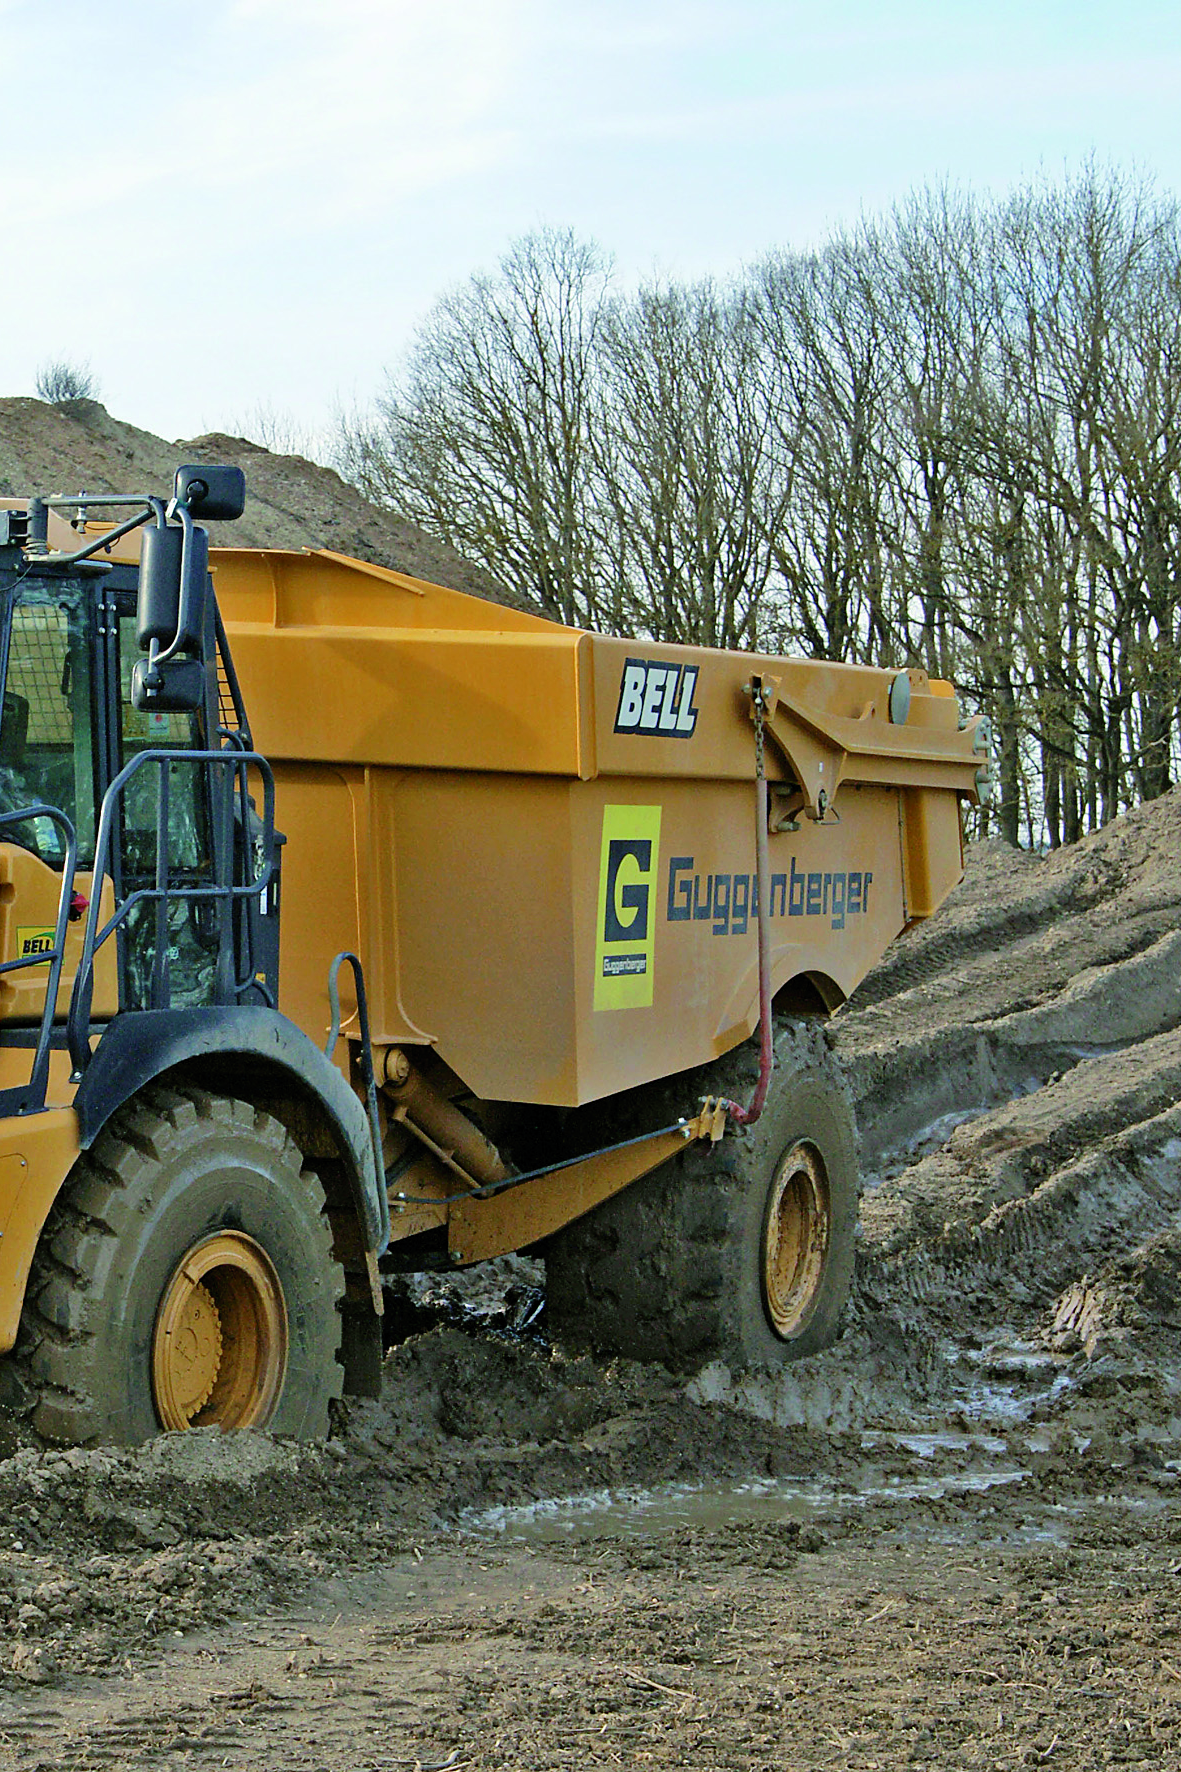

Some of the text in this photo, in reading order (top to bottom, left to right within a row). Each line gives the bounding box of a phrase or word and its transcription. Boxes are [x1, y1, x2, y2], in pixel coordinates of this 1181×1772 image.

[616, 662, 697, 733] BELL
[604, 840, 651, 942] G
[22, 939, 52, 953] BELL
